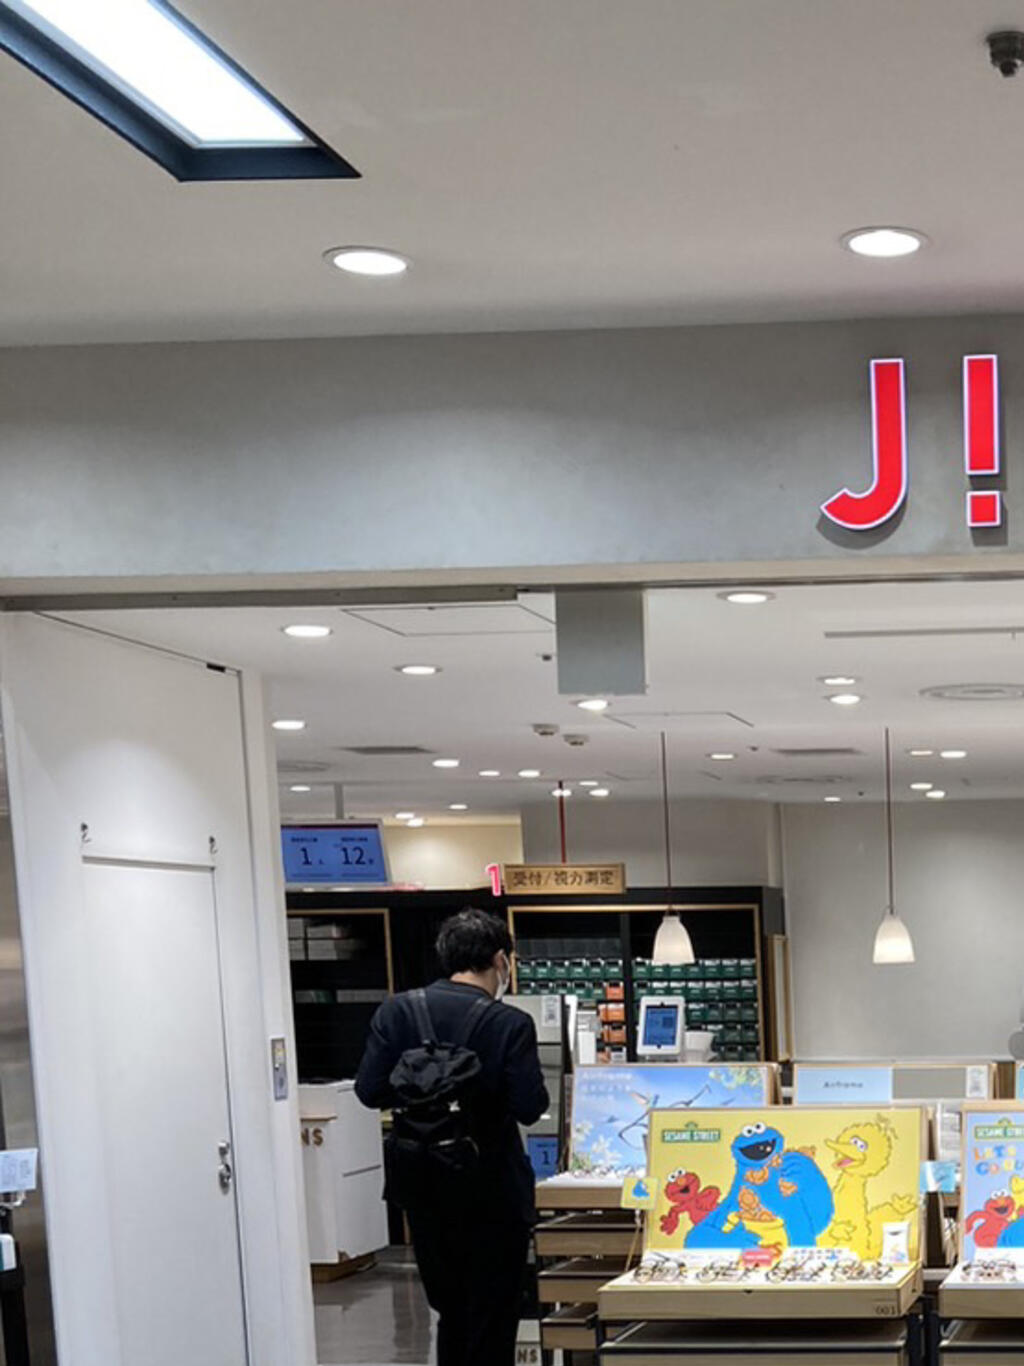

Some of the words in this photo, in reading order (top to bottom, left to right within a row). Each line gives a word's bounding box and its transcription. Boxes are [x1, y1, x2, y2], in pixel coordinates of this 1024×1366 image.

[300, 847, 313, 866] 1
[341, 846, 367, 866] 12
[486, 864, 501, 896] 1
